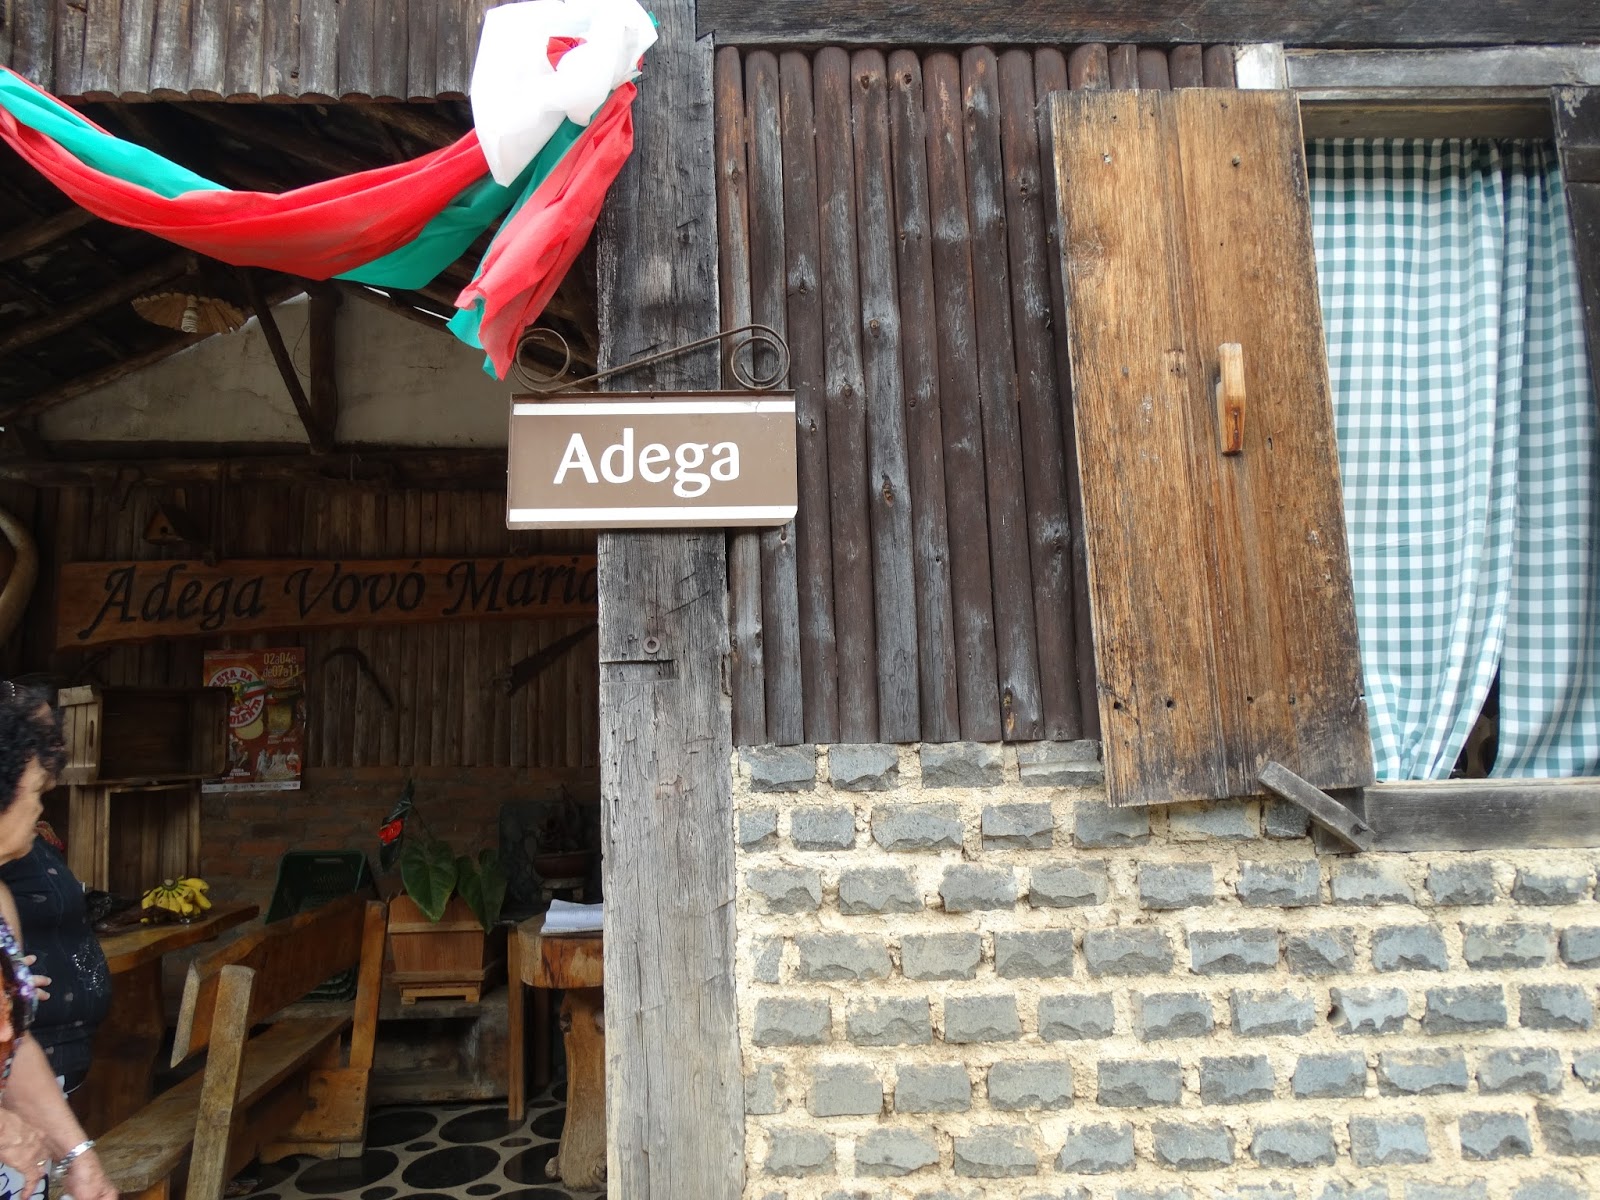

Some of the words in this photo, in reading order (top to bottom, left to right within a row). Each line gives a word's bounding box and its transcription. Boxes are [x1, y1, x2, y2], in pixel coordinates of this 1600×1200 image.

[553, 427, 740, 498] Adega
[77, 562, 266, 640] Adega
[284, 561, 426, 620] Vovó
[240, 670, 253, 681] DA
